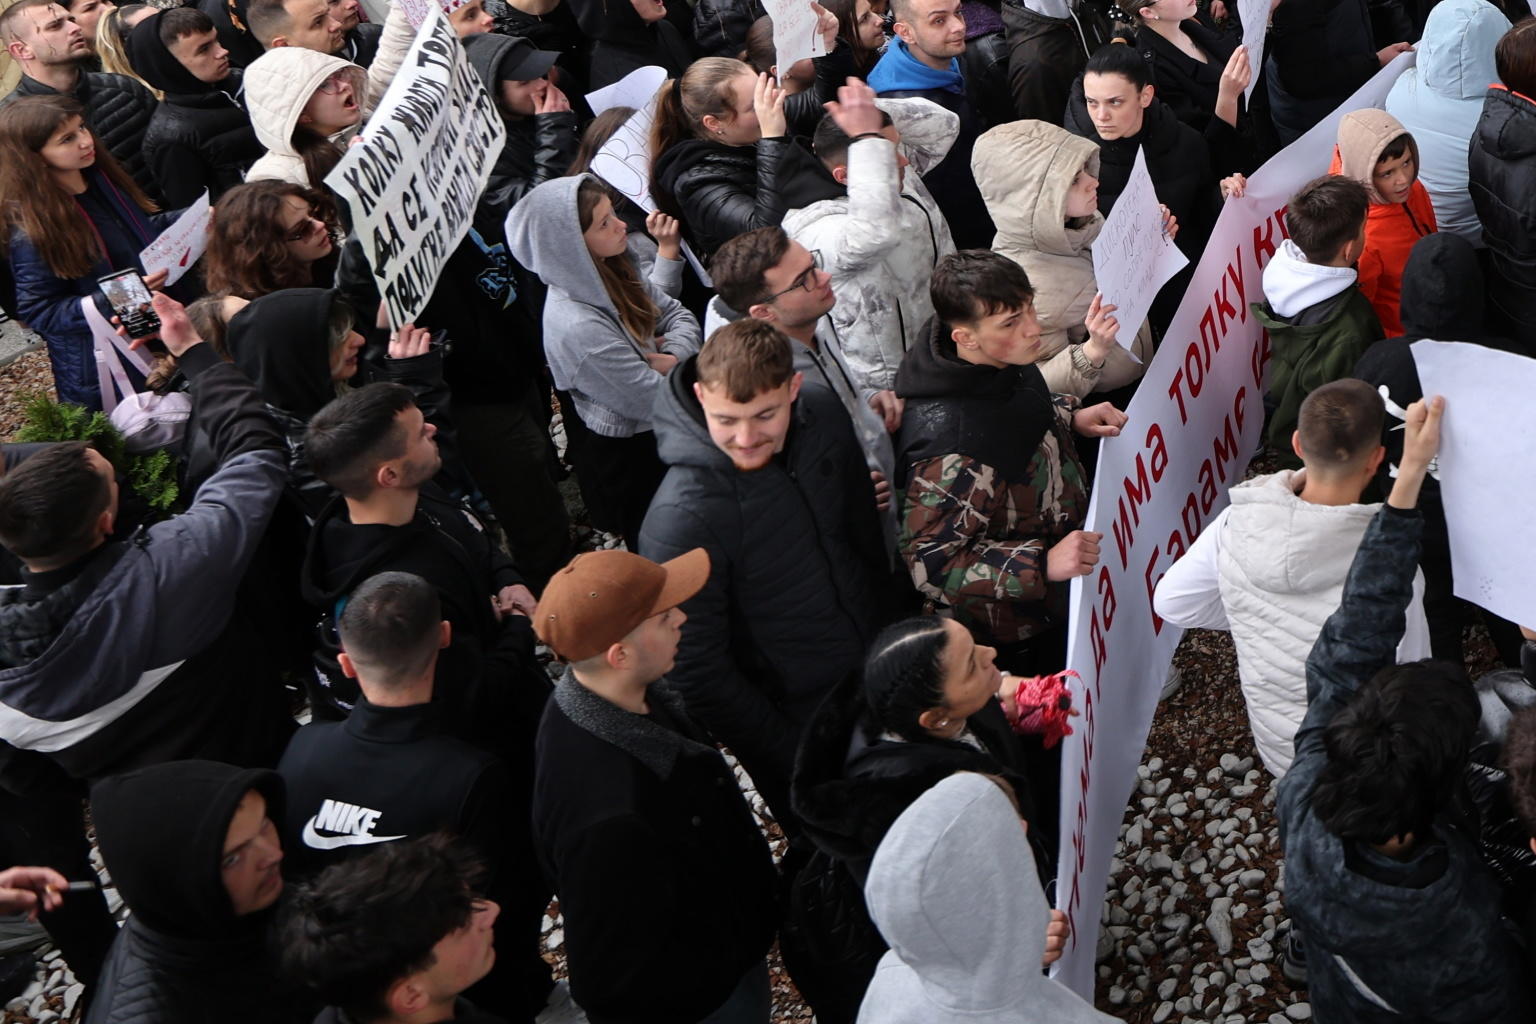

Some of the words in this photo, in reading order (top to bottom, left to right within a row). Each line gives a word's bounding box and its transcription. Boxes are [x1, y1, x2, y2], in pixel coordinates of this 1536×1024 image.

[342, 125, 404, 217] КОЛКУ
[373, 210, 405, 280] ДА
[401, 172, 429, 233] СЕ
[384, 222, 447, 333] ПОДИГНЕ
[314, 798, 383, 837] NIKE
